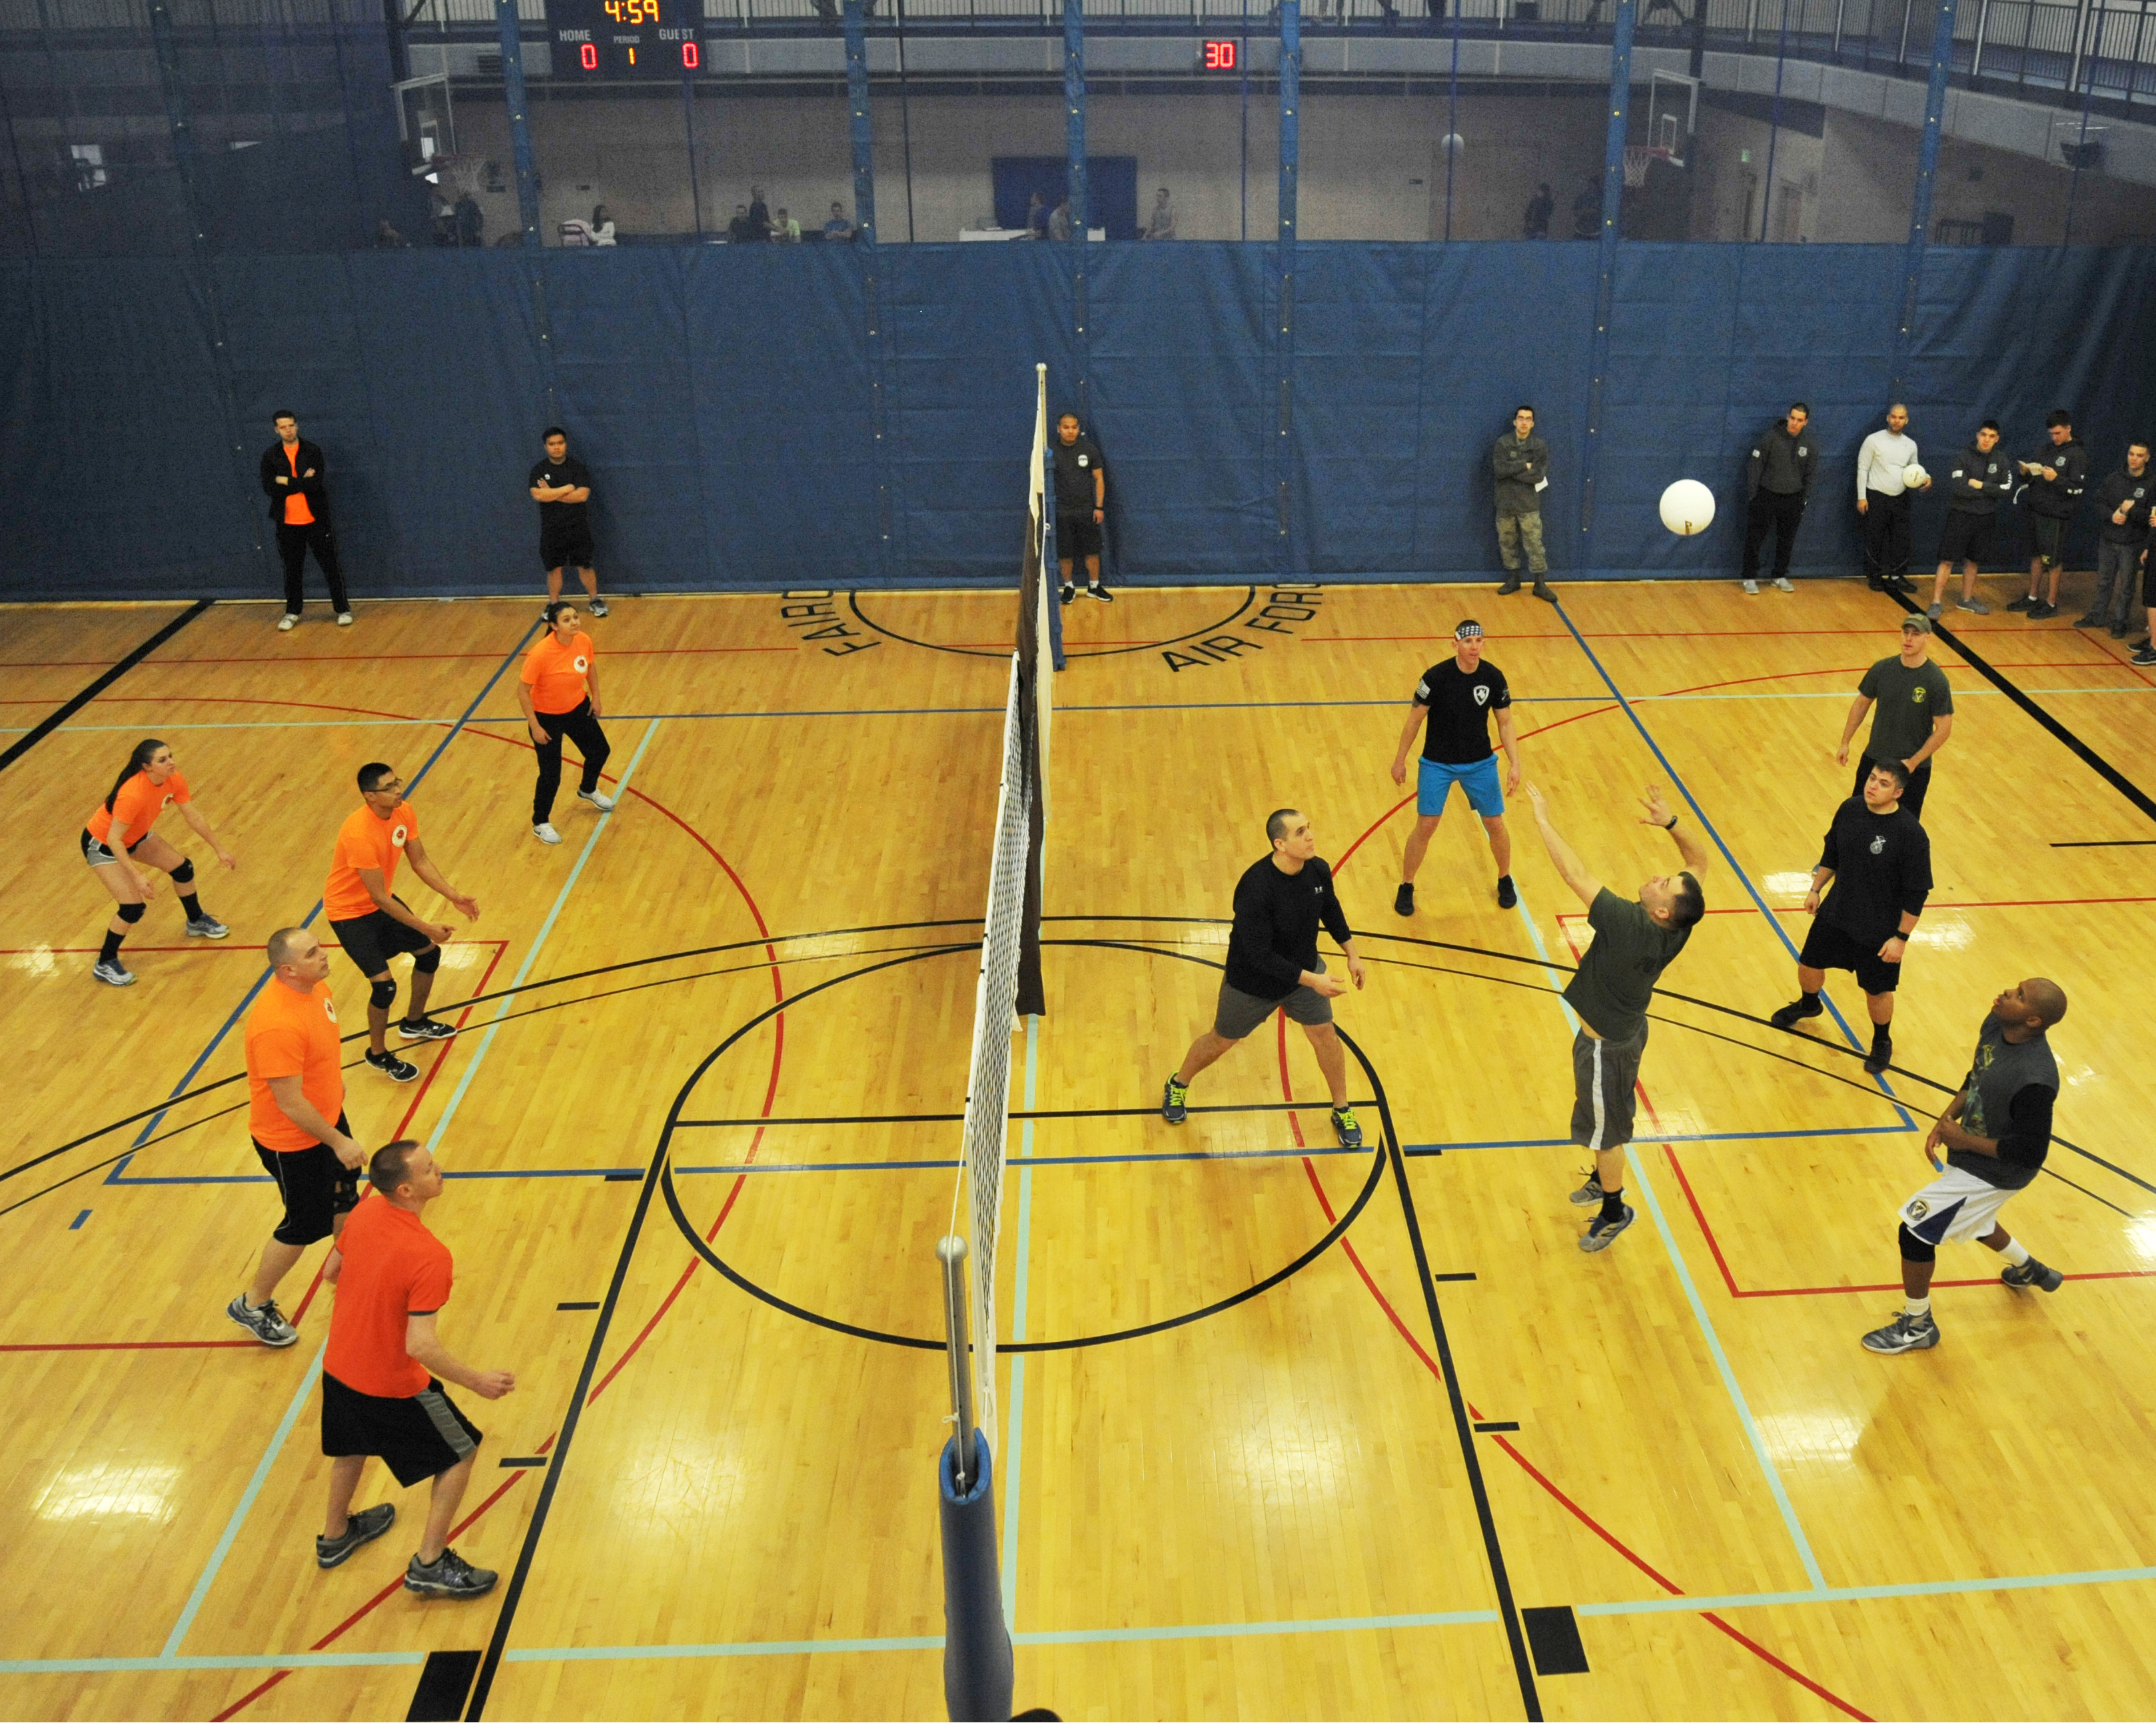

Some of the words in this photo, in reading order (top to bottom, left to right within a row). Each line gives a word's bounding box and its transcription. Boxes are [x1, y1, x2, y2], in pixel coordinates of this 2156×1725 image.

[604, 0, 660, 24] 4:59
[560, 30, 592, 41] HOME
[613, 35, 640, 44] PERIOD
[658, 28, 694, 40] GUEST
[580, 43, 598, 69] 0
[628, 47, 636, 65] 1
[682, 42, 699, 69] 0
[1205, 41, 1236, 69] 30
[1161, 635, 1264, 673] AIR
[1244, 584, 1324, 634] FOR
